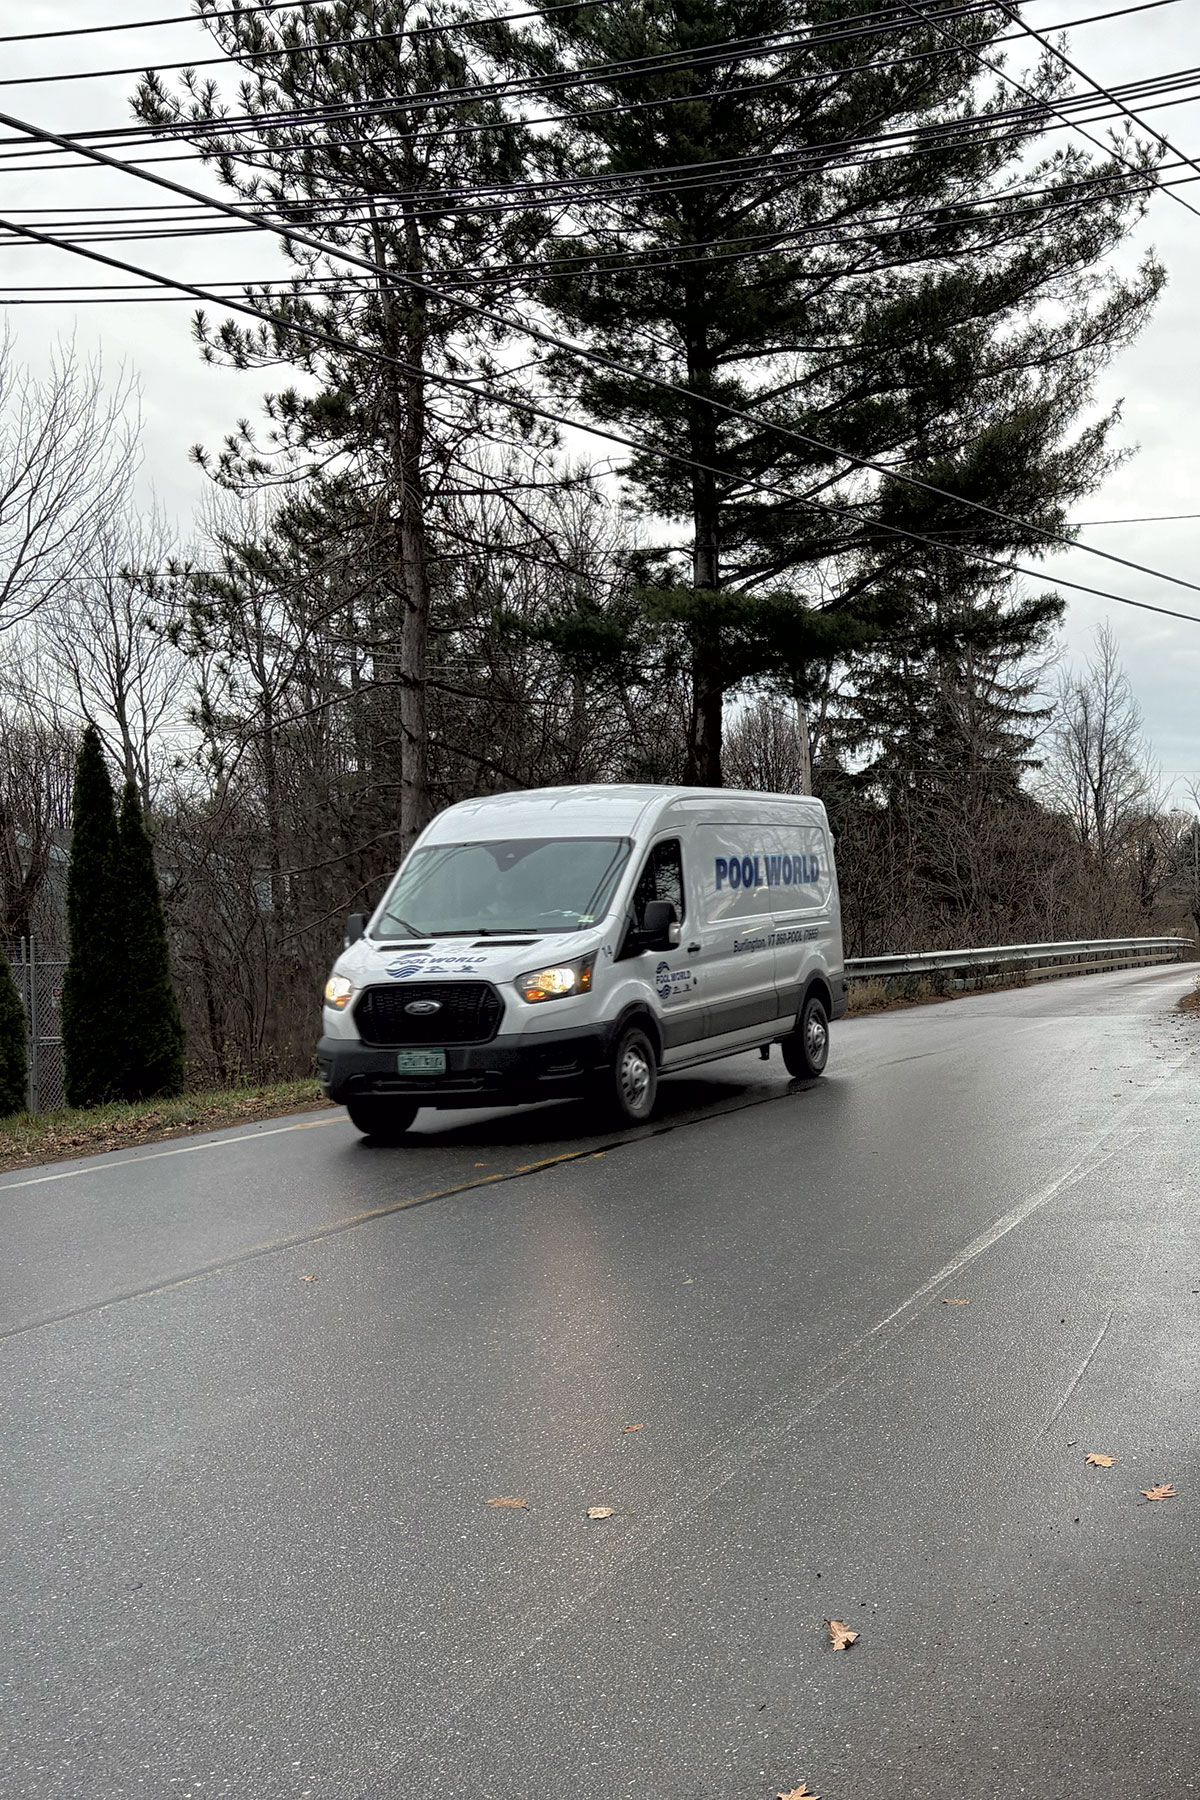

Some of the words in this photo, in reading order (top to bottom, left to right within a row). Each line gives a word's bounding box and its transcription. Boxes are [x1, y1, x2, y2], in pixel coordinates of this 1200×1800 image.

[715, 856, 764, 891] POOL
[765, 854, 820, 886] WORLD
[388, 957, 428, 966] POOL
[429, 956, 488, 964] WORLD
[656, 974, 671, 984] POOL
[671, 970, 691, 982] WORLD
